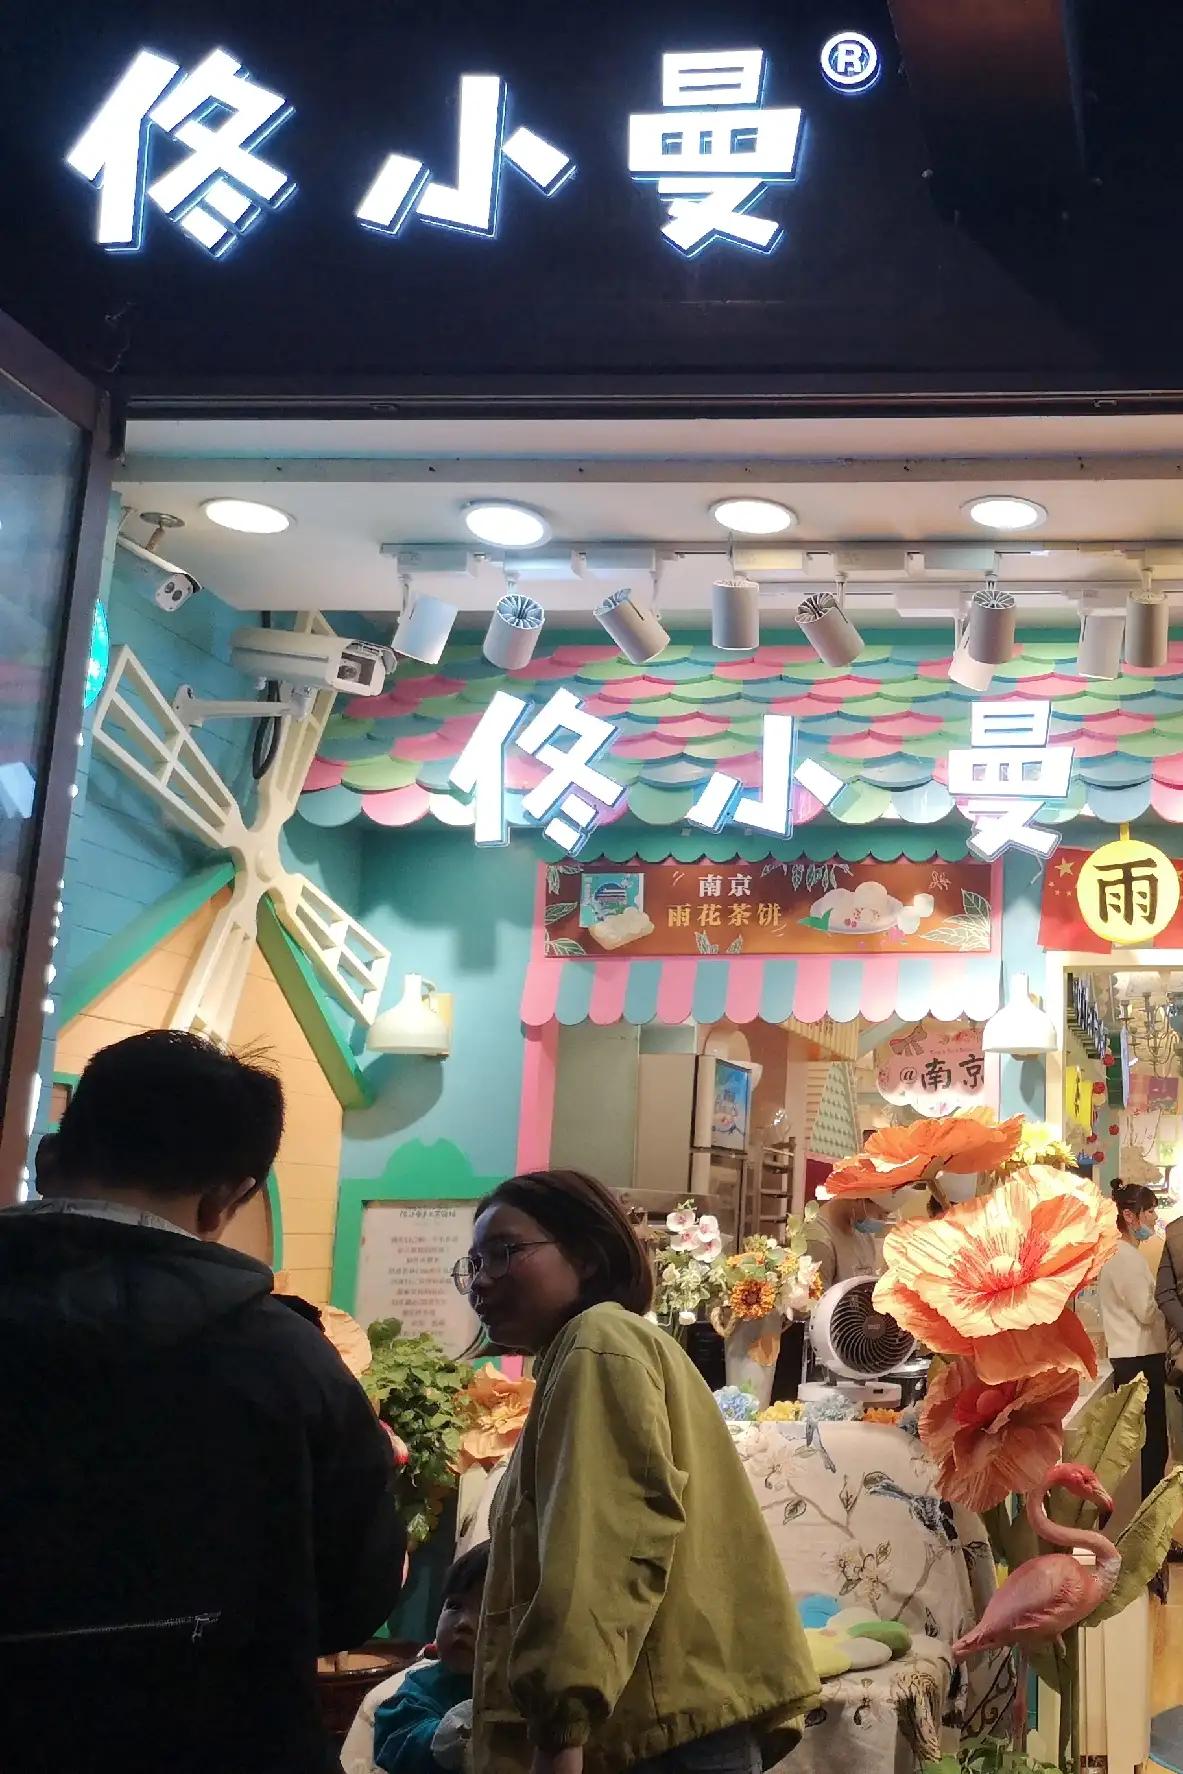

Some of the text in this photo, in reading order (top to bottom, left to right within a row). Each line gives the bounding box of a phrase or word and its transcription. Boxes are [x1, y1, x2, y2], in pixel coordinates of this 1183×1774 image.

[66, 47, 803, 259] 佟小曼
[448, 687, 1075, 861] 佟小曼
[666, 903, 782, 927] 雨花茶饼
[698, 873, 753, 898] 南京
